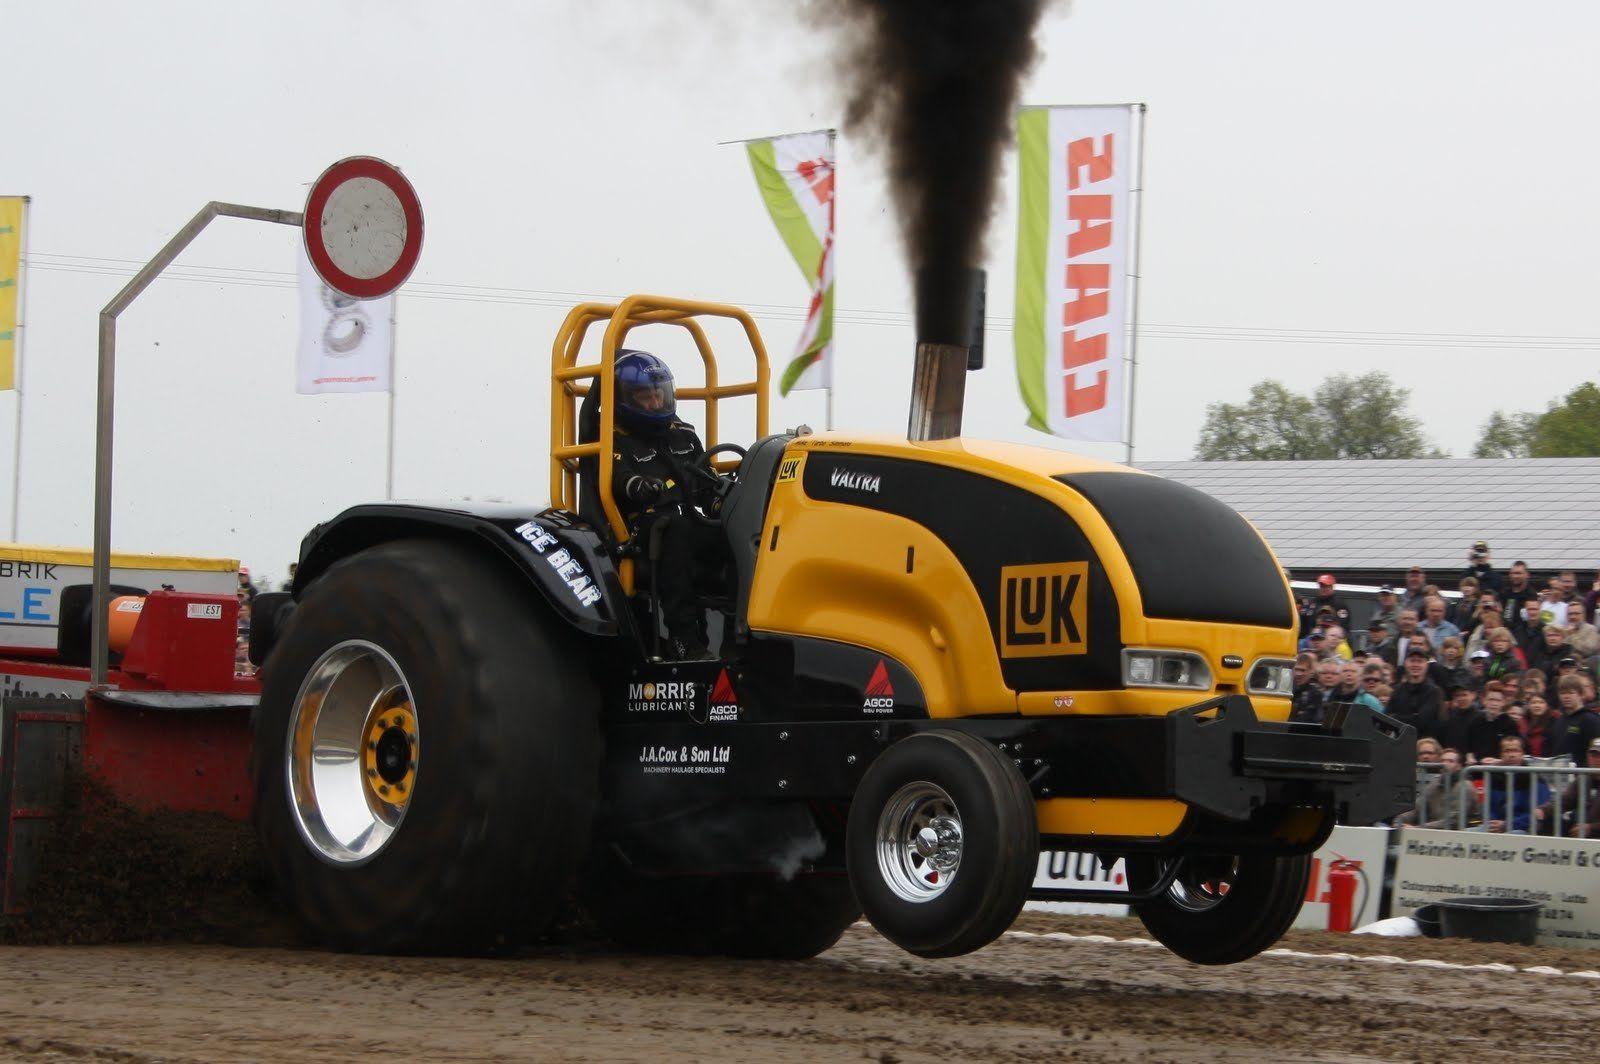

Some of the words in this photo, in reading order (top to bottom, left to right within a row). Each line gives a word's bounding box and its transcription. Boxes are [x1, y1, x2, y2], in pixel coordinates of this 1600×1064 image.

[831, 468, 880, 492] VALTRA
[514, 521, 559, 553] ICE
[546, 548, 602, 607] BEAR
[629, 682, 696, 700] MORRIS
[710, 705, 738, 715] AGCO
[863, 698, 893, 707] AGCO
[680, 746, 688, 762] &
[691, 746, 710, 762] Son
[713, 746, 730, 762] Ltd
[643, 766, 671, 774] MACHINERY
[671, 766, 694, 774] HAULAGE
[695, 766, 726, 774] SPECIALISTS
[1523, 847, 1571, 865] GmbH
[1576, 850, 1589, 867] &
